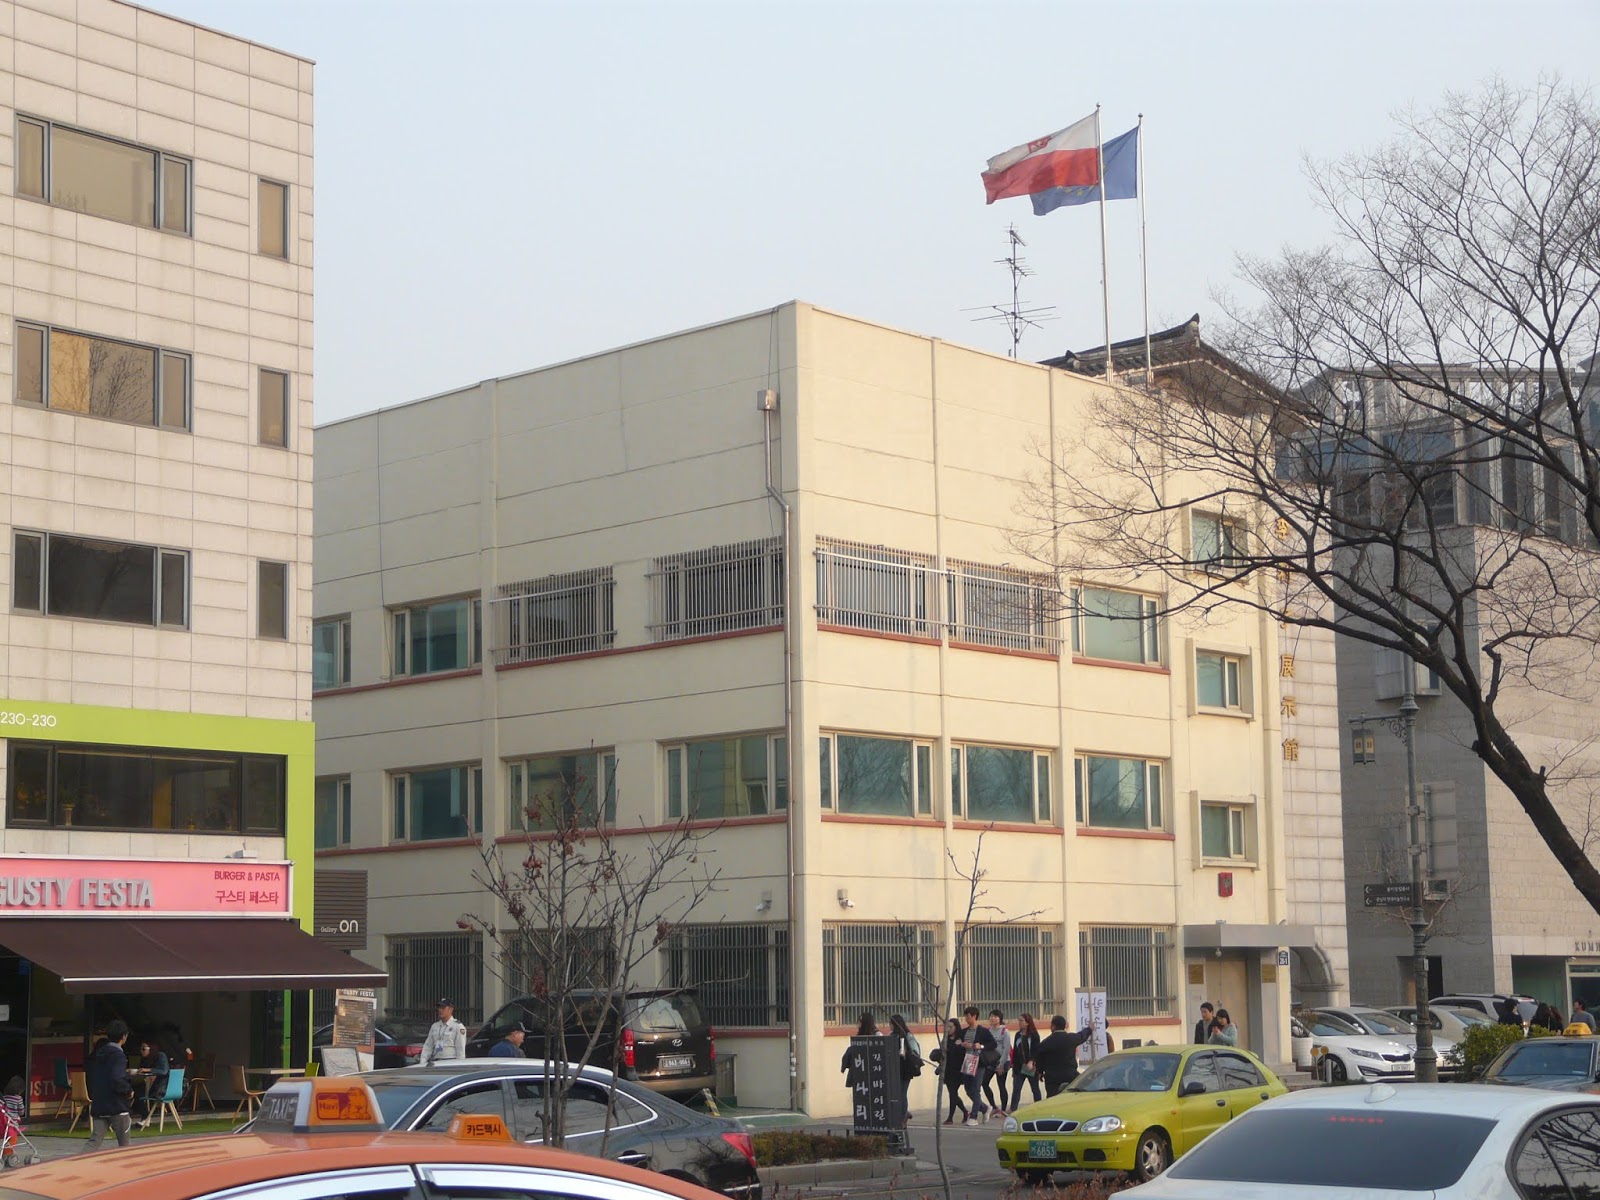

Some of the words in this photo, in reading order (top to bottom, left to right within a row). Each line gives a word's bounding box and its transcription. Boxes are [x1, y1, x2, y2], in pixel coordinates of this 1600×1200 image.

[0, 711, 57, 727] 230-230
[214, 870, 246, 880] BURGER
[247, 872, 253, 881] &
[255, 872, 280, 881] PASTA
[79, 877, 154, 907] FESTA
[215, 890, 246, 904] 구스티
[249, 891, 279, 904] 페스타
[854, 1053, 869, 1120] 비나리
[268, 1098, 290, 1120] TAXI
[320, 1102, 338, 1111] Navi
[466, 1123, 502, 1137] 카드택시
[1036, 1146, 1055, 1157] 6853
